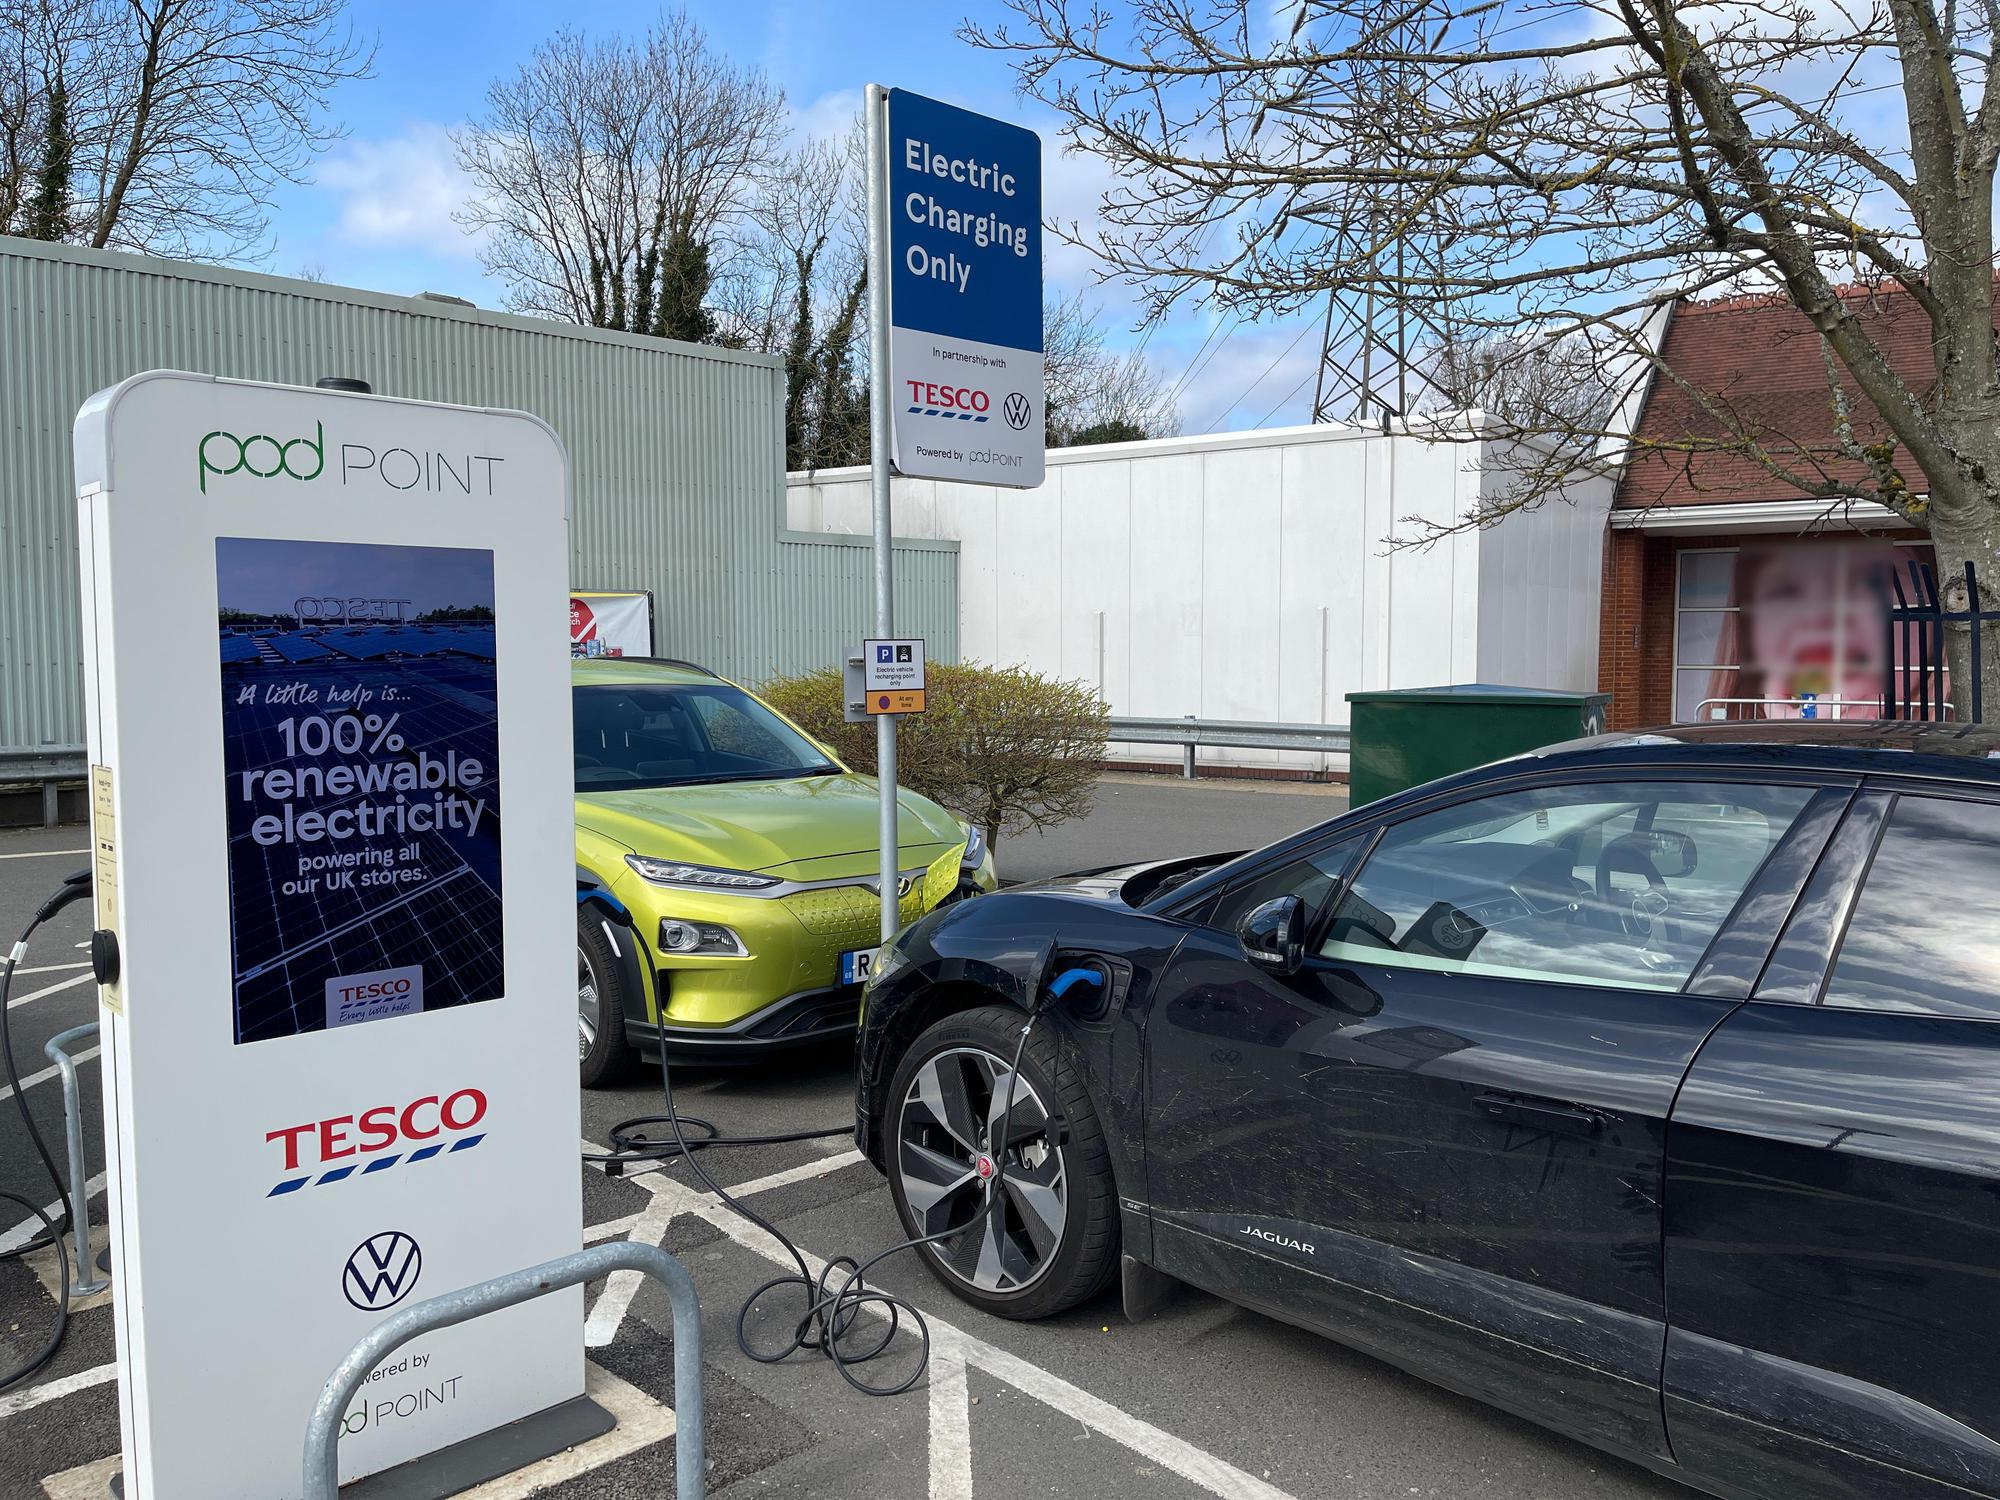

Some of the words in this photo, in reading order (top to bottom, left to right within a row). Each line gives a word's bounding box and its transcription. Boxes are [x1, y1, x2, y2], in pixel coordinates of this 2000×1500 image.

[905, 138, 1015, 197] Electric
[905, 192, 1027, 257] Charging
[906, 244, 971, 293] Only
[932, 347, 940, 358] In
[942, 350, 988, 367] partnership
[990, 359, 1006, 369] with
[907, 380, 990, 412] TESCO
[199, 420, 324, 496] pod
[341, 443, 505, 496] POINT
[916, 446, 952, 459] Powered
[954, 450, 963, 462] by
[969, 449, 991, 467] pod
[993, 453, 1023, 467] POINT
[881, 649, 889, 660] P
[235, 684, 256, 706] A
[265, 683, 318, 704] little
[326, 683, 372, 710] help
[381, 687, 412, 702] is...
[278, 712, 404, 758] 100%
[242, 750, 483, 801] renewable
[251, 792, 485, 846] electricity
[298, 846, 394, 876] powering
[399, 843, 420, 861] all
[282, 876, 320, 896] our
[326, 870, 355, 889] UK
[360, 868, 428, 887] stores.
[339, 979, 411, 1002] TESCO
[339, 1010, 366, 1023] Every
[368, 1005, 388, 1016] little
[391, 1002, 411, 1014] helps
[265, 1088, 488, 1171] TESCO
[1239, 1226, 1315, 1256] JAGUAR
[361, 1358, 407, 1386] wered
[413, 1353, 430, 1368] by
[376, 1375, 463, 1427] POINT
